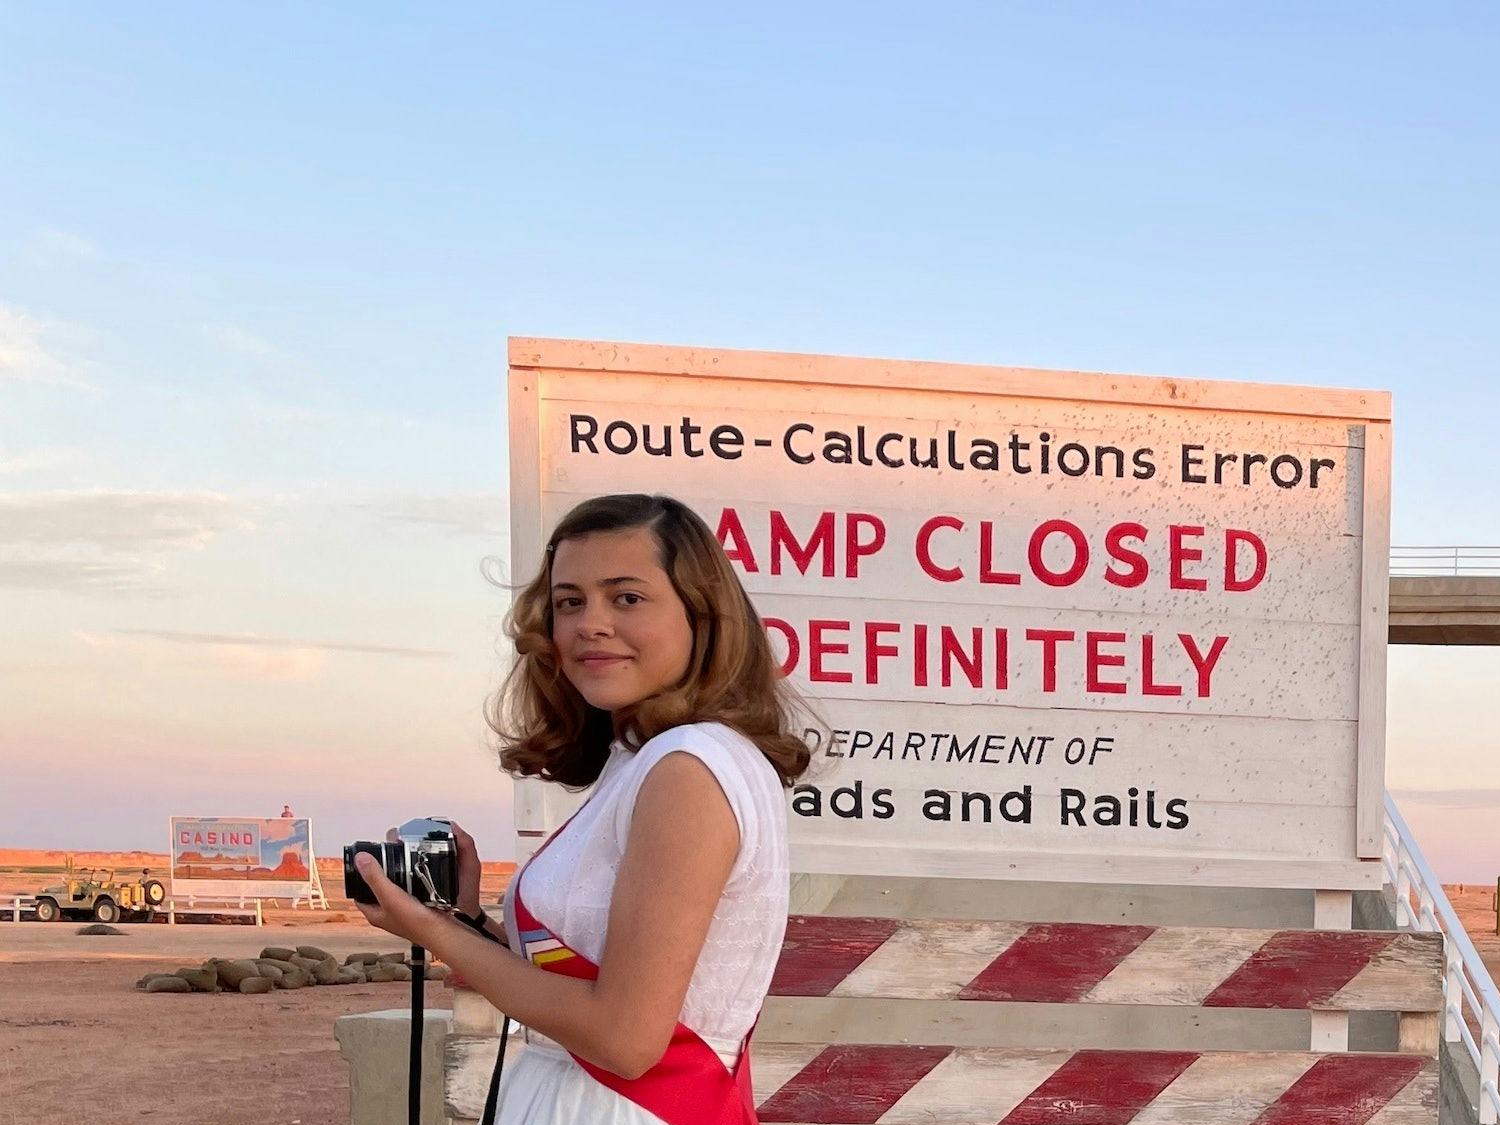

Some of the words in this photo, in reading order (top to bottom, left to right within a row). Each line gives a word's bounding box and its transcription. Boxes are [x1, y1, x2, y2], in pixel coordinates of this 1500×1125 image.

[570, 414, 1156, 480] Route-Calculations
[1181, 444, 1336, 489] Error
[715, 507, 886, 578] AMP
[915, 515, 1268, 592] CLOSED
[762, 617, 1230, 698] DEFINITELY
[803, 727, 1055, 765] DEPARTMENT
[1064, 737, 1115, 766] OF
[792, 780, 895, 820] ads
[922, 784, 1032, 824] and
[1060, 787, 1190, 830] Rails
[181, 831, 253, 845] CASINO
